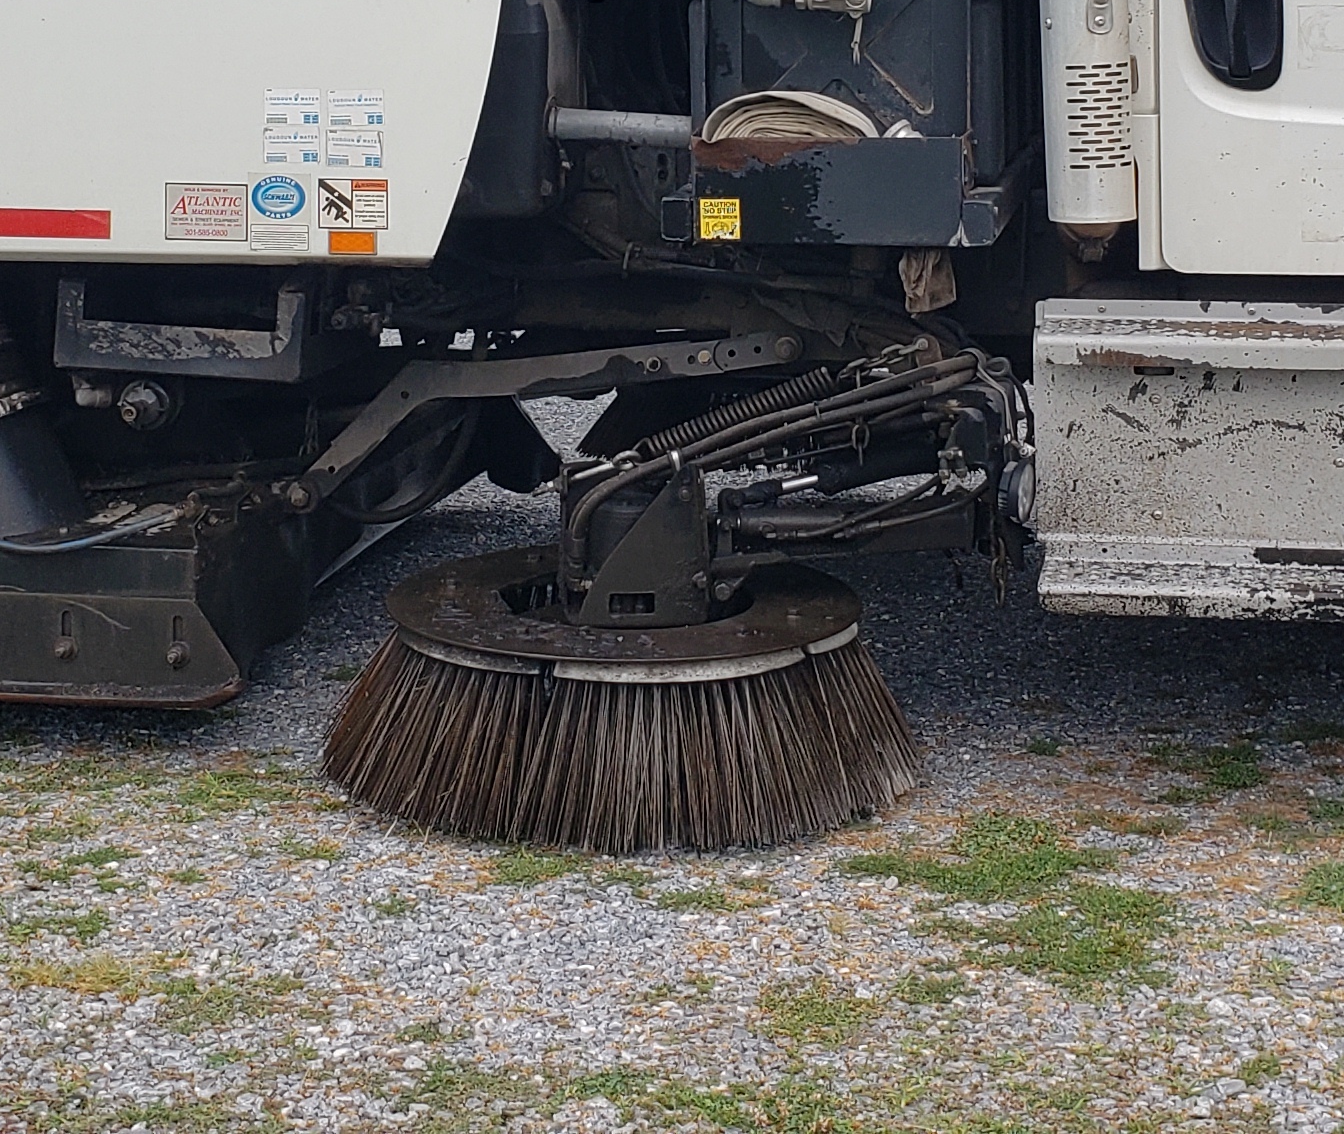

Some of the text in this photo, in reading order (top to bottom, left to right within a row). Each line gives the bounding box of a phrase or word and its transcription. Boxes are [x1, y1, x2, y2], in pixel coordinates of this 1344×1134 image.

[170, 195, 242, 215] ATLANTIC
[191, 208, 227, 216] MACHINERY
[265, 211, 292, 219] PARTS
